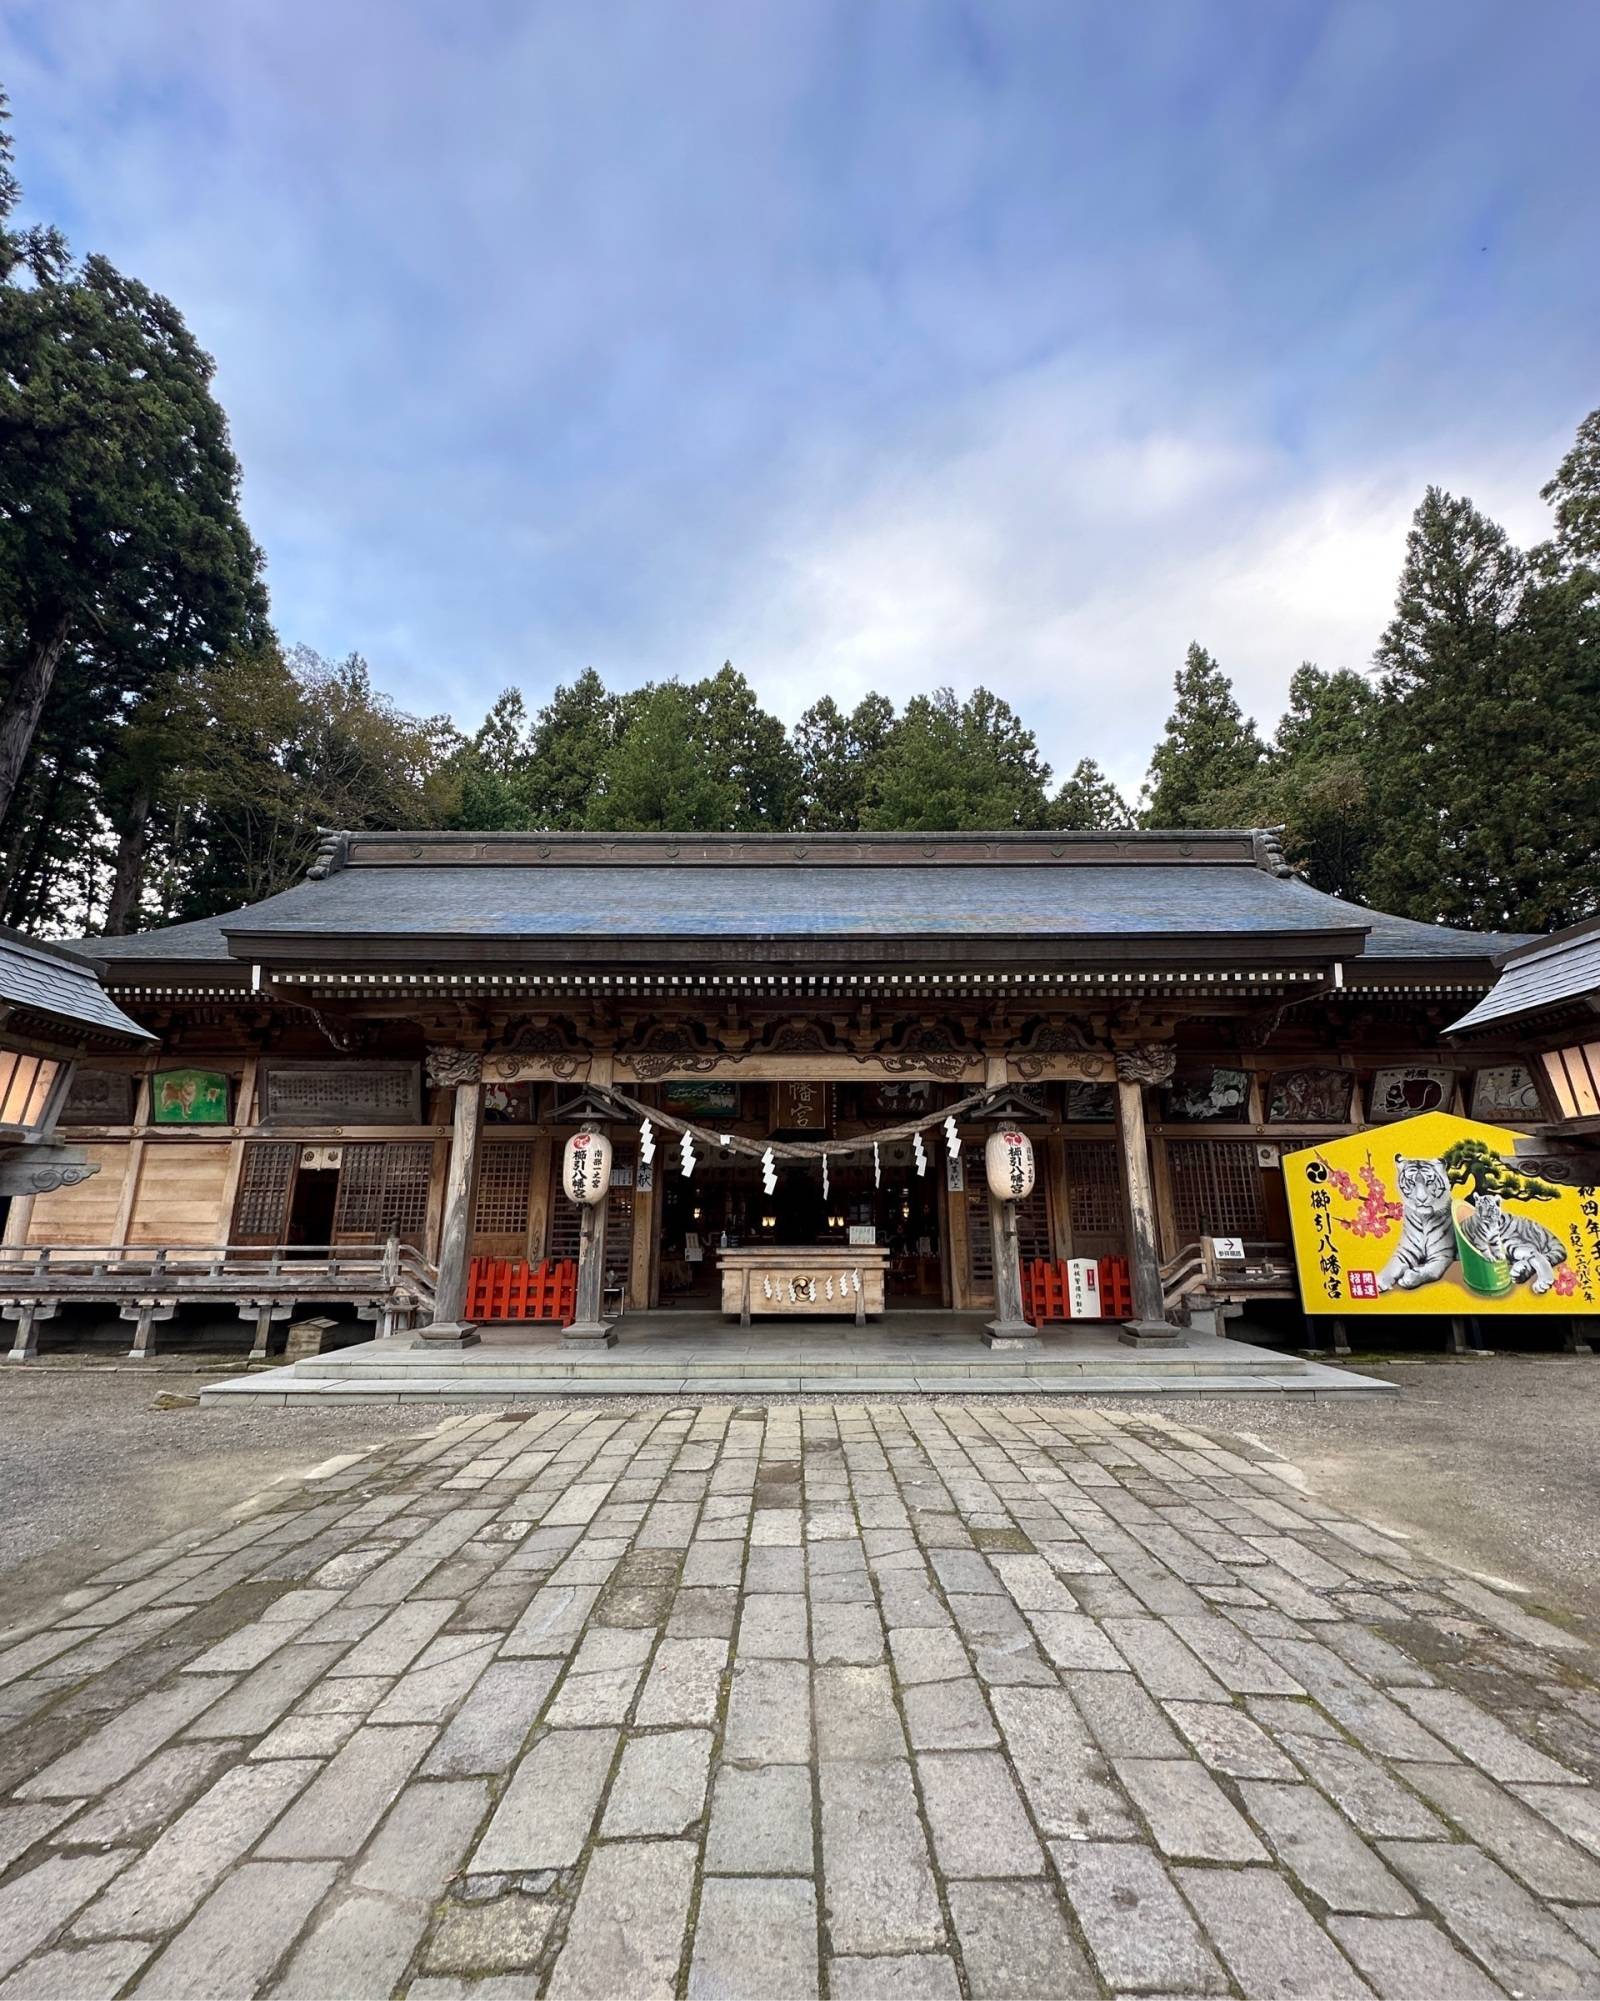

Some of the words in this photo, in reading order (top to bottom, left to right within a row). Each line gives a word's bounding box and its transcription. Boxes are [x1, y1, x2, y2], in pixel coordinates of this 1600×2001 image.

[572, 1149, 588, 1199] 櫛引八幡宮
[1007, 1146, 1024, 1194] 櫛引八幡宮
[1310, 1188, 1342, 1299] 櫛引八幡宮
